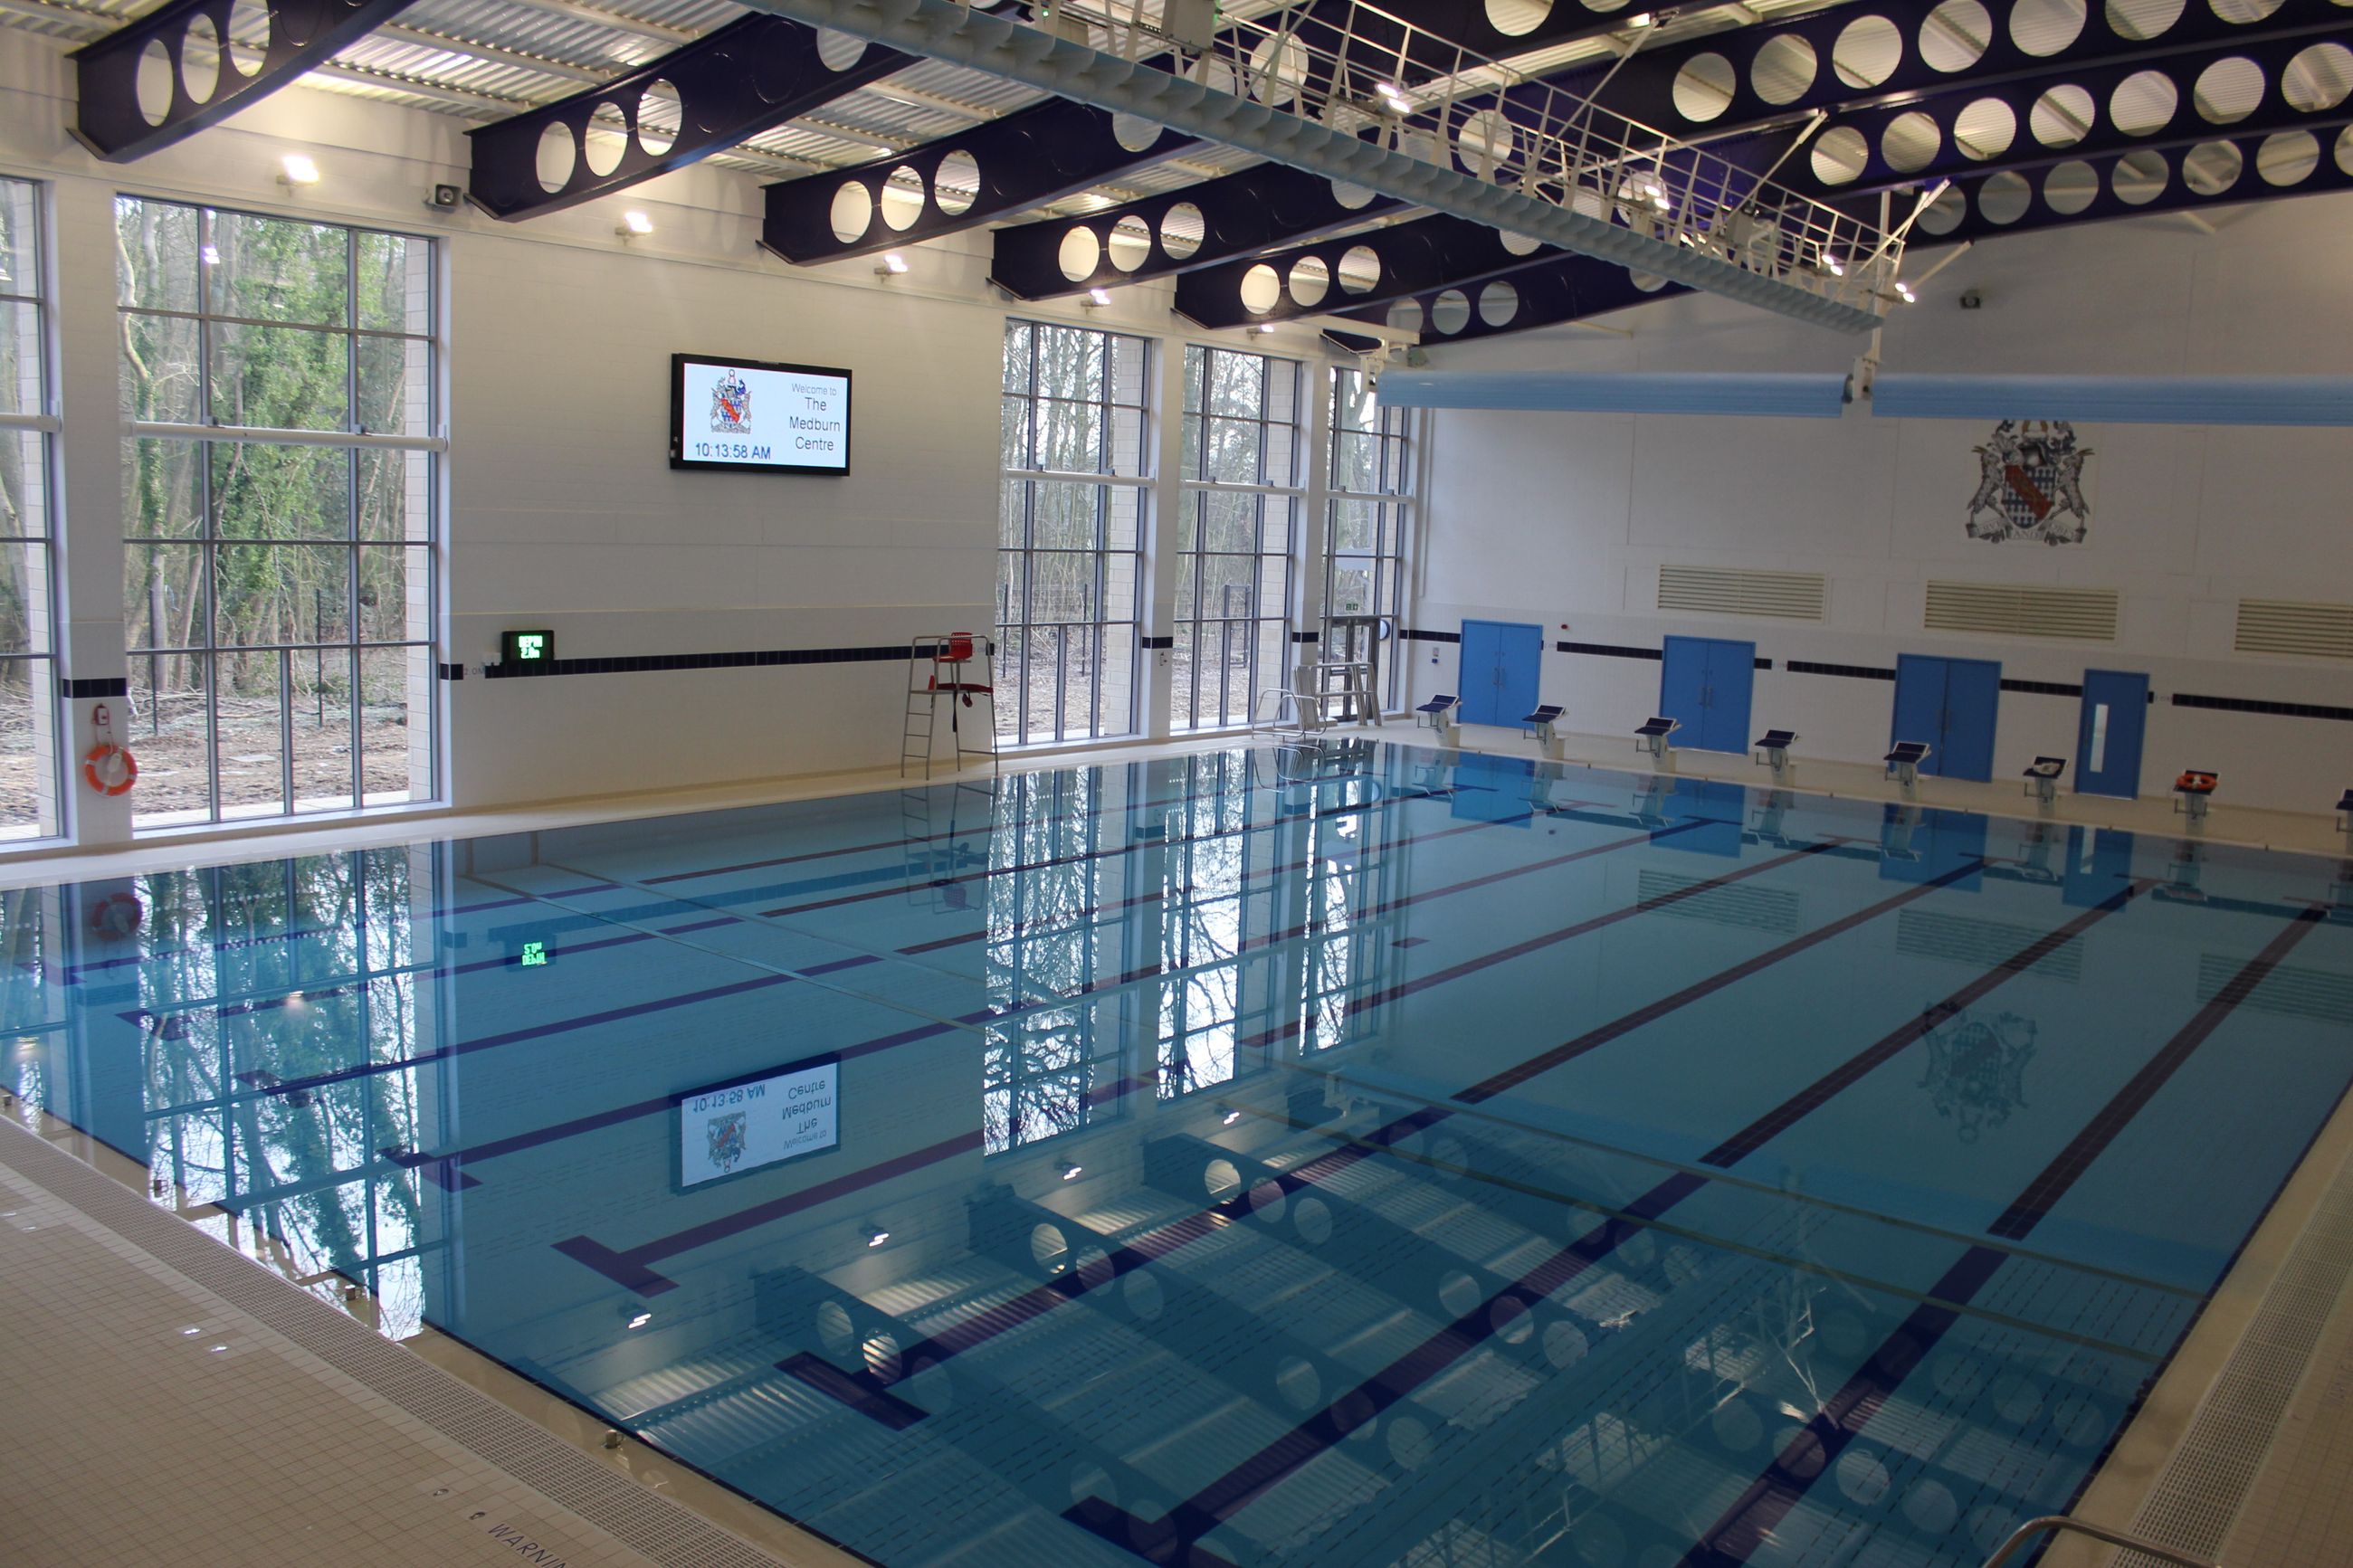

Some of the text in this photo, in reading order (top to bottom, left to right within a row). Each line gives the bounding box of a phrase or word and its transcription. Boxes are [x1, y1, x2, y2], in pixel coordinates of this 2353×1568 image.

[791, 383, 837, 396] Welcome to
[805, 396, 827, 412] The
[789, 416, 841, 432] Medburn
[695, 442, 771, 460] 10:13:58 AM
[795, 436, 834, 451] Centre
